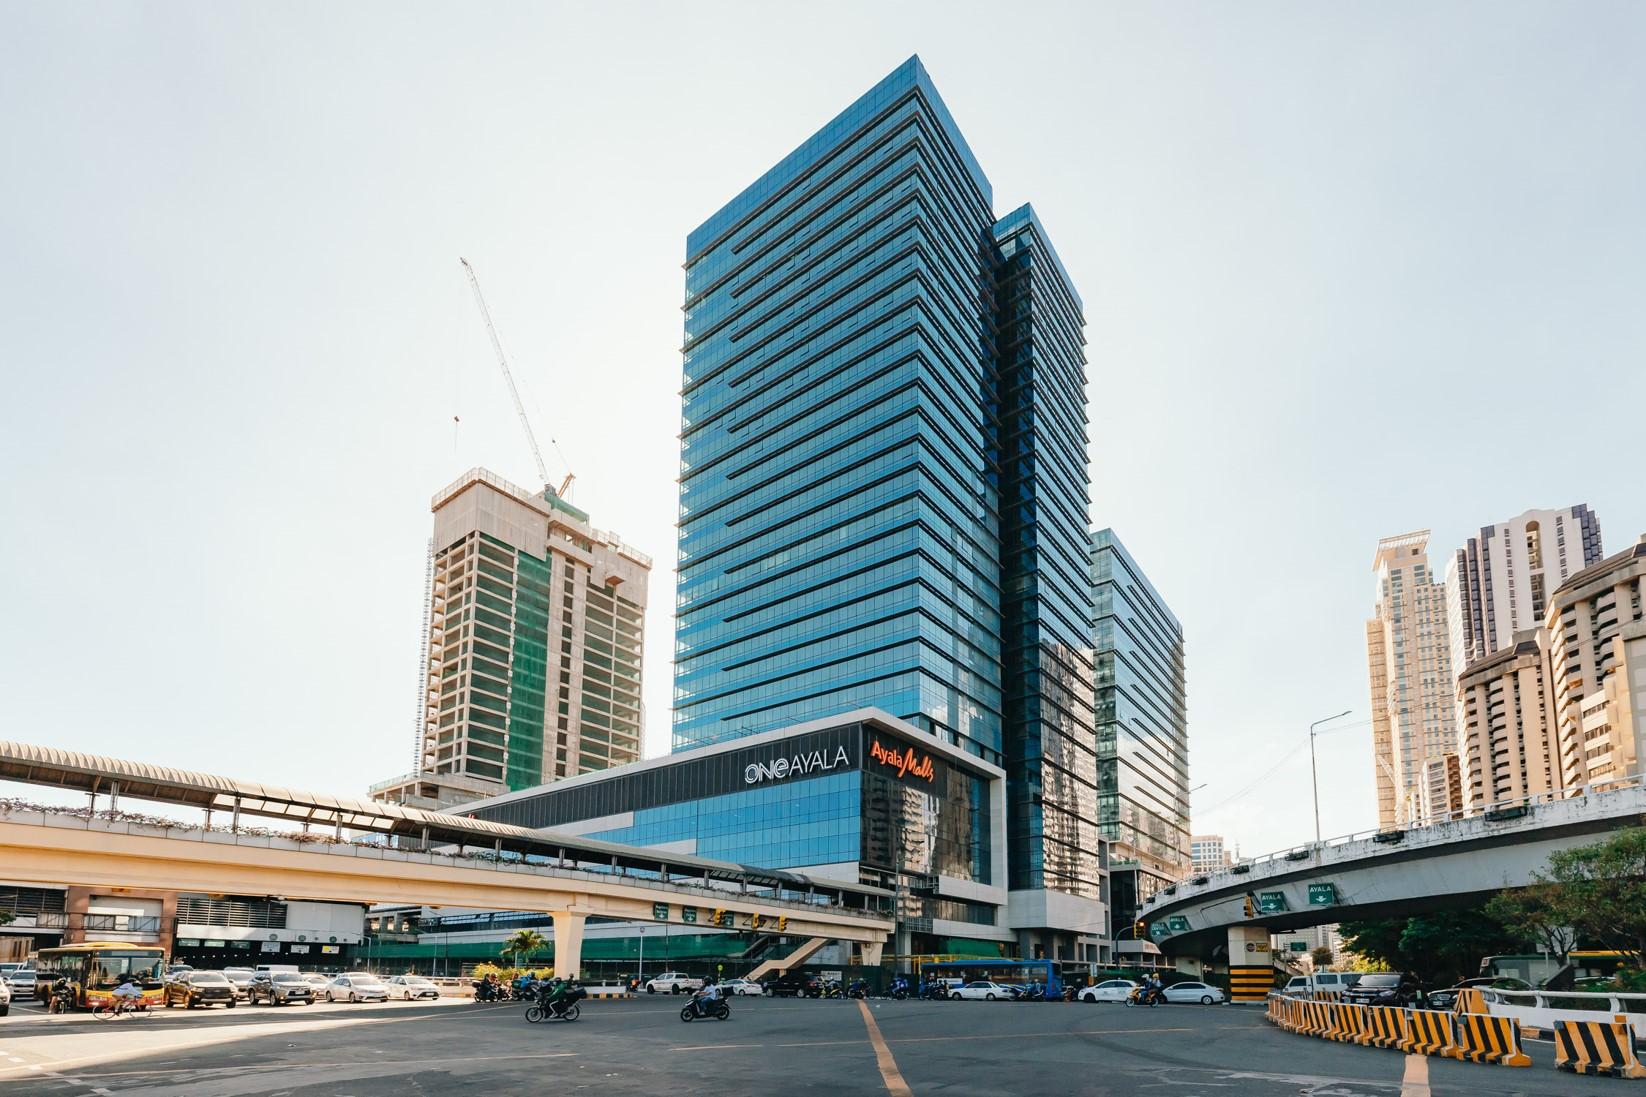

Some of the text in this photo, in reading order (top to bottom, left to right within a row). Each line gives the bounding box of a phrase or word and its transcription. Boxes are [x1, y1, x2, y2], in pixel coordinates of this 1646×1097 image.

[789, 746, 850, 777] AYALA
[870, 740, 935, 783] Ayala Malls
